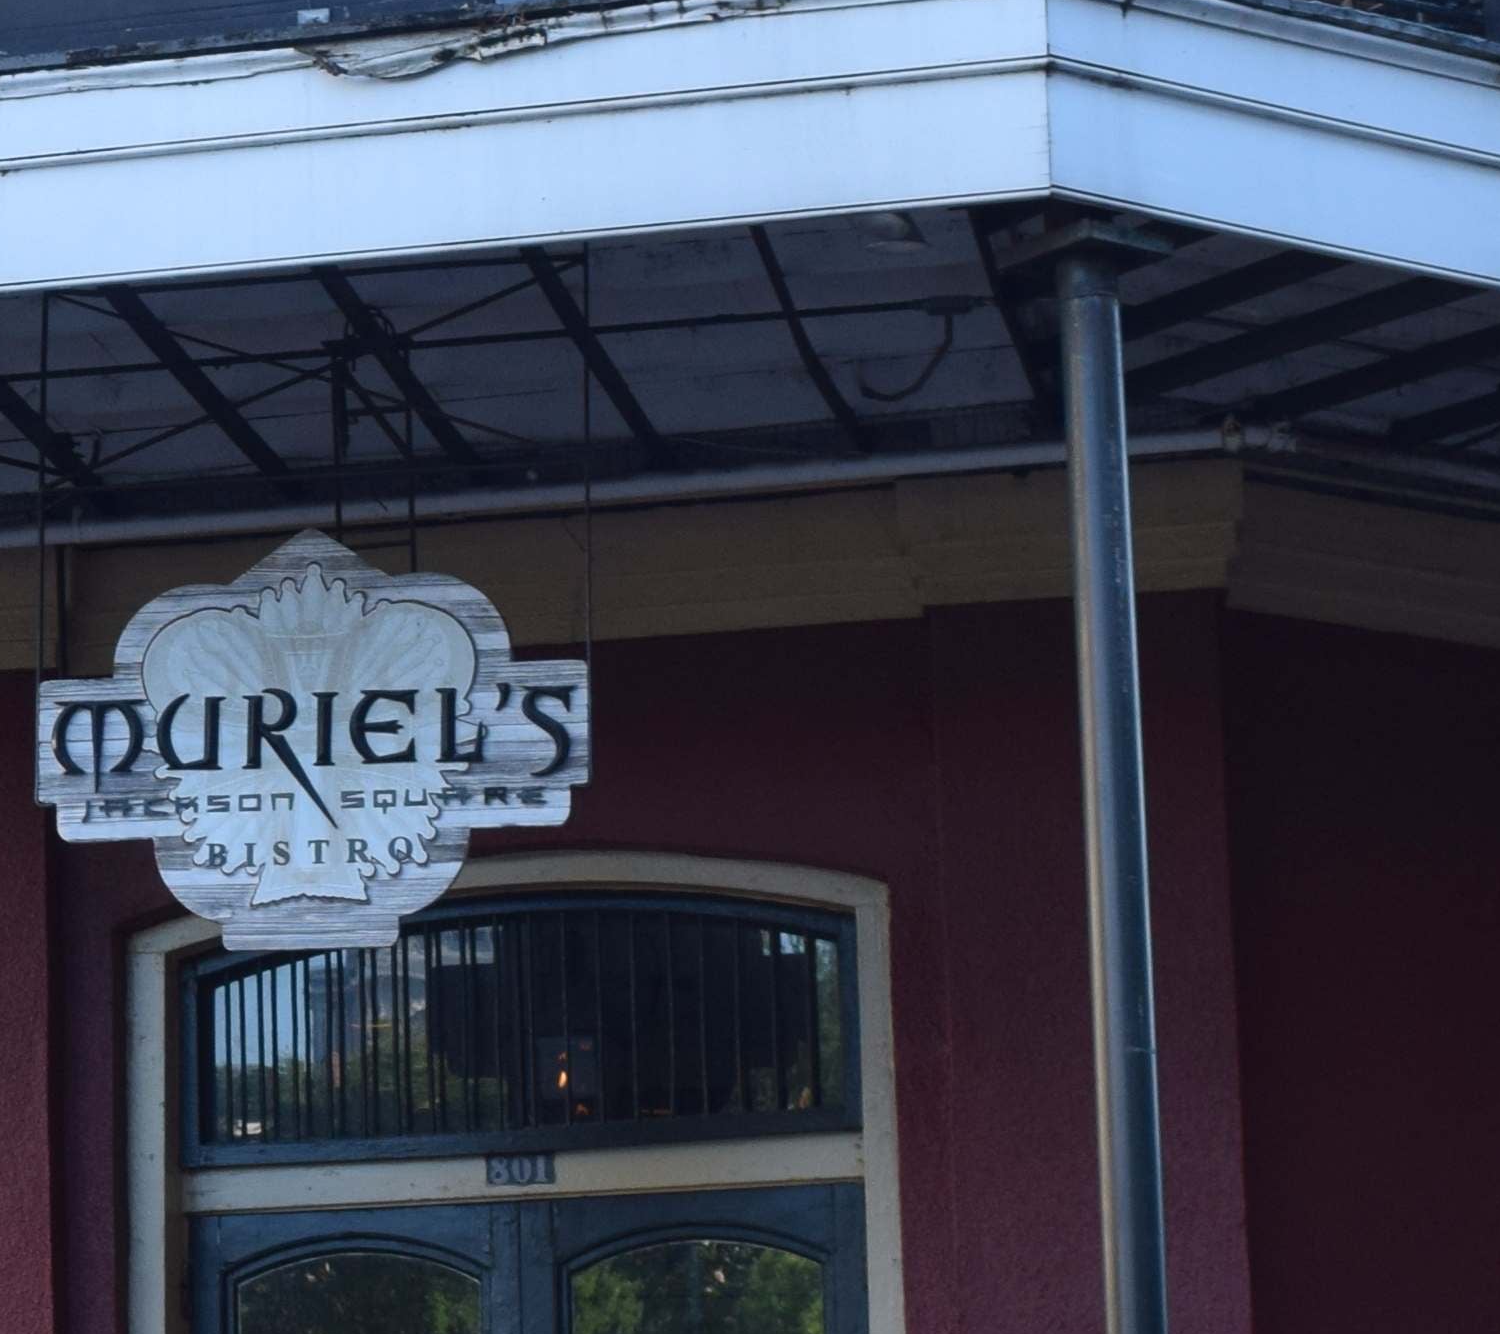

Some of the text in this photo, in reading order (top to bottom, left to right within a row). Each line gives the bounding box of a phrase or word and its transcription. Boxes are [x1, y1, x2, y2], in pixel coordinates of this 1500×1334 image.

[51, 682, 579, 829] MURIEL'S
[81, 785, 548, 824] JACKSON SQUARE
[205, 835, 414, 868] BISTRO
[489, 1155, 550, 1184] 801
